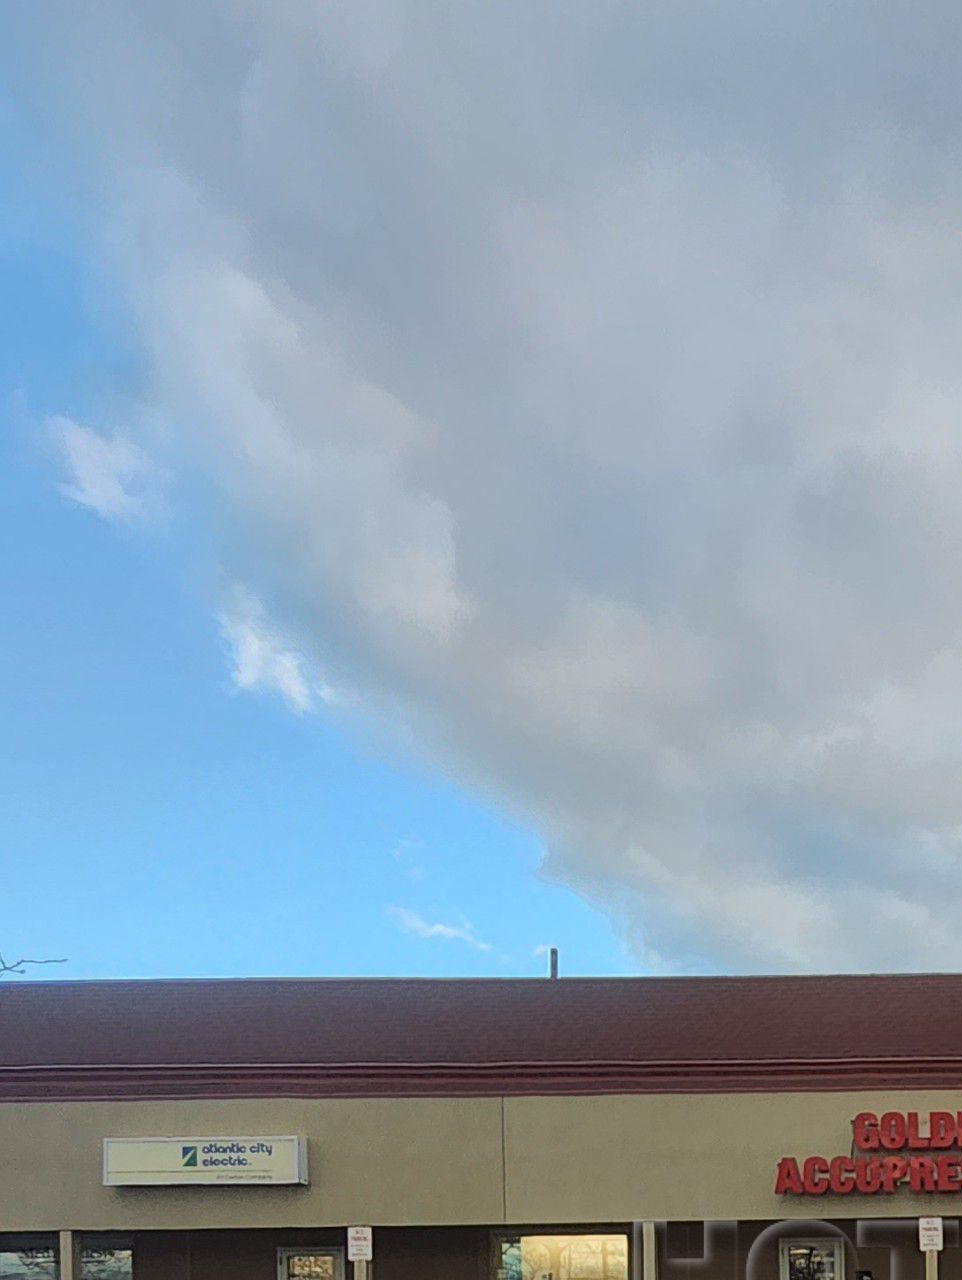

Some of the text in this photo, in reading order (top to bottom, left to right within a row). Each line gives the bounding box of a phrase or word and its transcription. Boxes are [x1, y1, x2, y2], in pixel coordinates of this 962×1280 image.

[202, 1143, 273, 1156] atlantic city
[202, 1156, 248, 1167] electric
